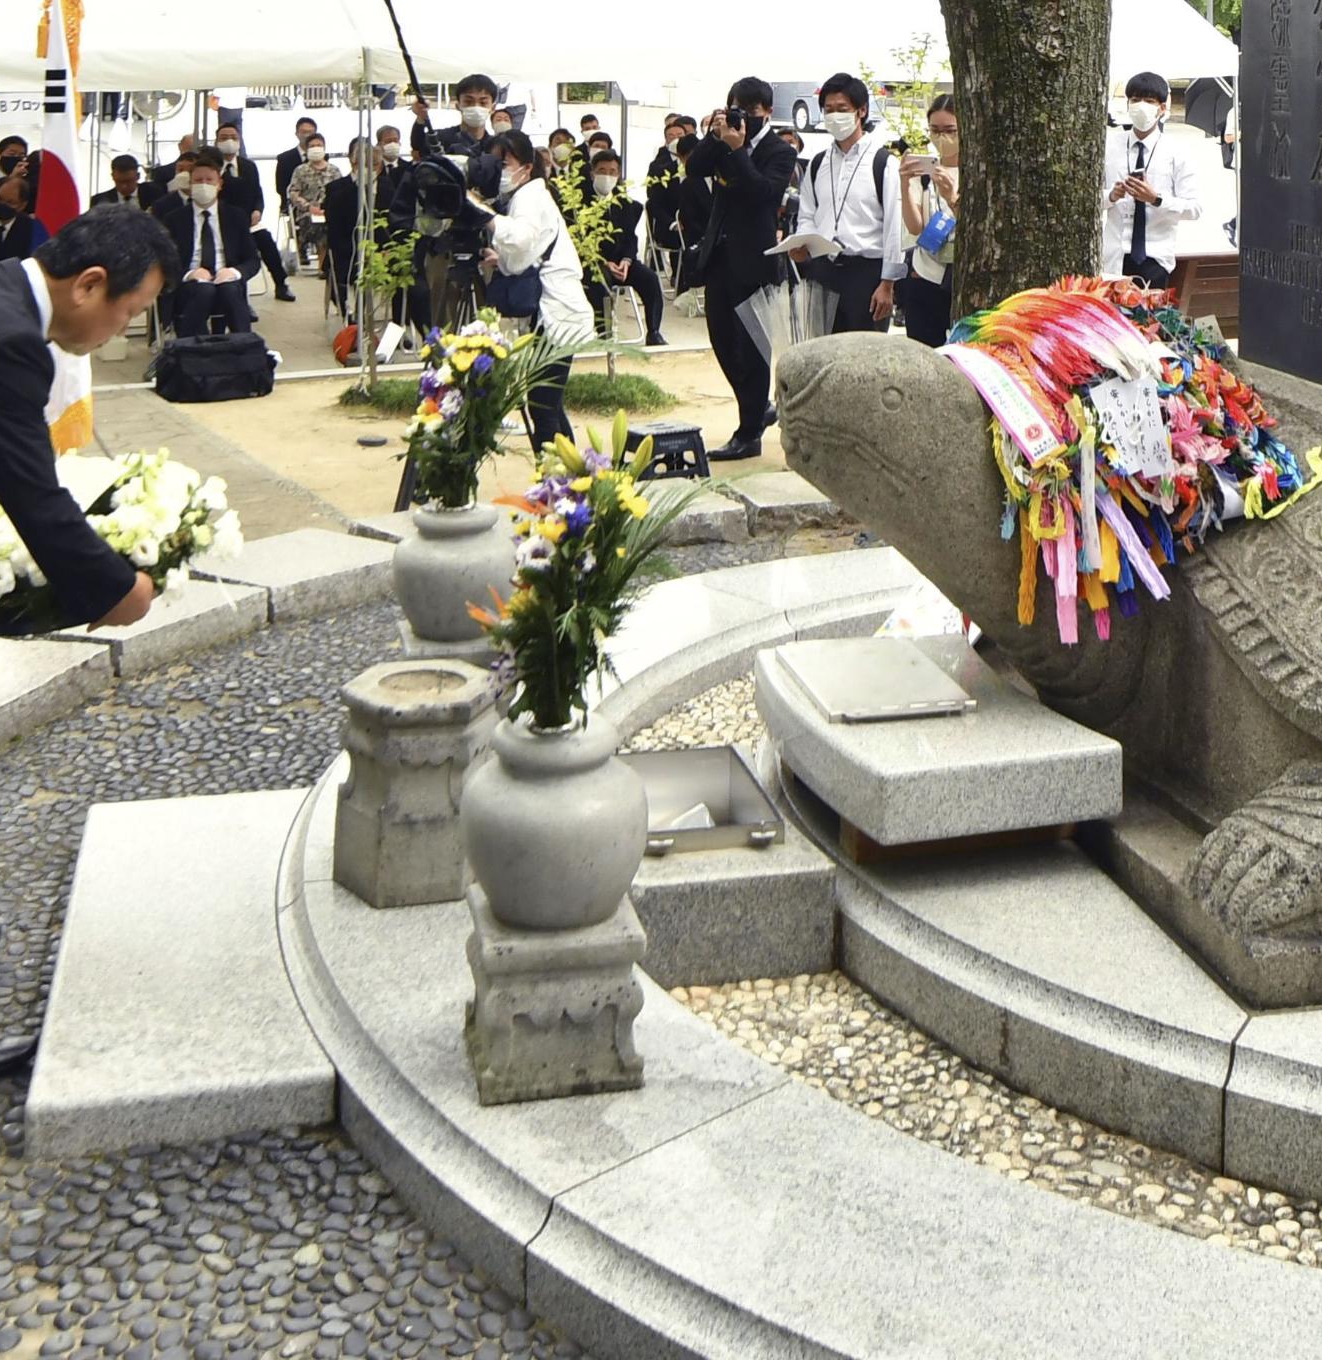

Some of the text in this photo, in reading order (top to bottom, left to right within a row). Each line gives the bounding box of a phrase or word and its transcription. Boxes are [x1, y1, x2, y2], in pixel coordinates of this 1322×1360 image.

[0, 99, 45, 113] B ブロッ
